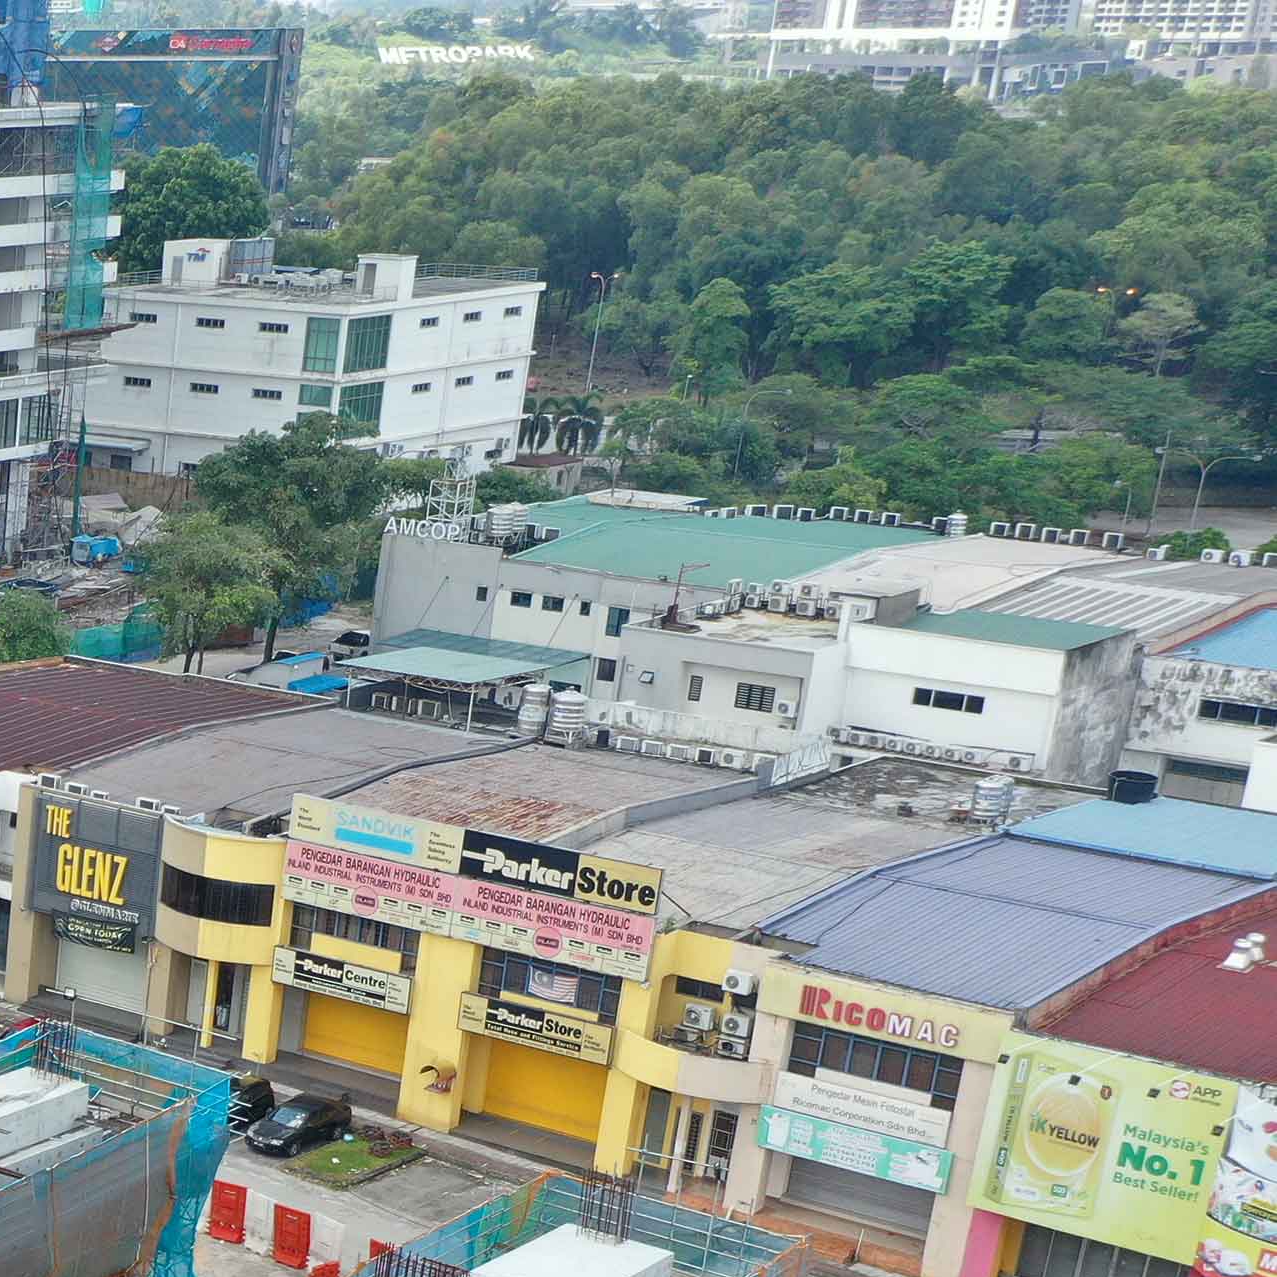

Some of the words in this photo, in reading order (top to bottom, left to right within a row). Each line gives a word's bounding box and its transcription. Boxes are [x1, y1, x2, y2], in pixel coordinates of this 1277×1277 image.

[46, 805, 73, 838] THE
[336, 809, 414, 840] SANDVIK
[56, 843, 129, 905] GLENZ
[288, 858, 311, 872] INLAND
[314, 864, 352, 881] INDUSTRIAL
[356, 873, 402, 893] INSTRUMENTS
[419, 887, 434, 900] SDN
[437, 892, 452, 904] BHD
[301, 847, 343, 868] PENGEDAR
[346, 857, 395, 878] BARANGAN
[396, 868, 442, 889] HYDRAULIC
[483, 847, 574, 890] Parker
[577, 867, 656, 906] Store
[463, 897, 488, 912] INLAND
[491, 903, 533, 922] INDUSTRIAL
[537, 913, 588, 934] INSTRUMENTS
[607, 929, 623, 941] SDN
[626, 932, 643, 945] BHD
[478, 886, 523, 907] PENGEDAR
[526, 897, 576, 917] BARANGAN
[580, 910, 631, 931] HYDRAULIC
[303, 959, 343, 979] Parker
[345, 969, 386, 989] Centre
[496, 1008, 543, 1031] Parker
[544, 1018, 582, 1039] Store
[799, 985, 959, 1047] RICOMAC
[811, 1084, 851, 1102] Pengedar
[1192, 1085, 1222, 1099] APP
[793, 1096, 831, 1113] Ricomac
[833, 1106, 884, 1126] Corporation
[886, 1119, 905, 1131] Sdn
[1048, 1123, 1101, 1149] YELLOW
[1123, 1123, 1210, 1156] Malaysia's
[1116, 1142, 1178, 1180] No.
[1190, 1159, 1207, 1186] 1
[1112, 1171, 1146, 1191] Best
[1149, 1180, 1200, 1203] Seller!
